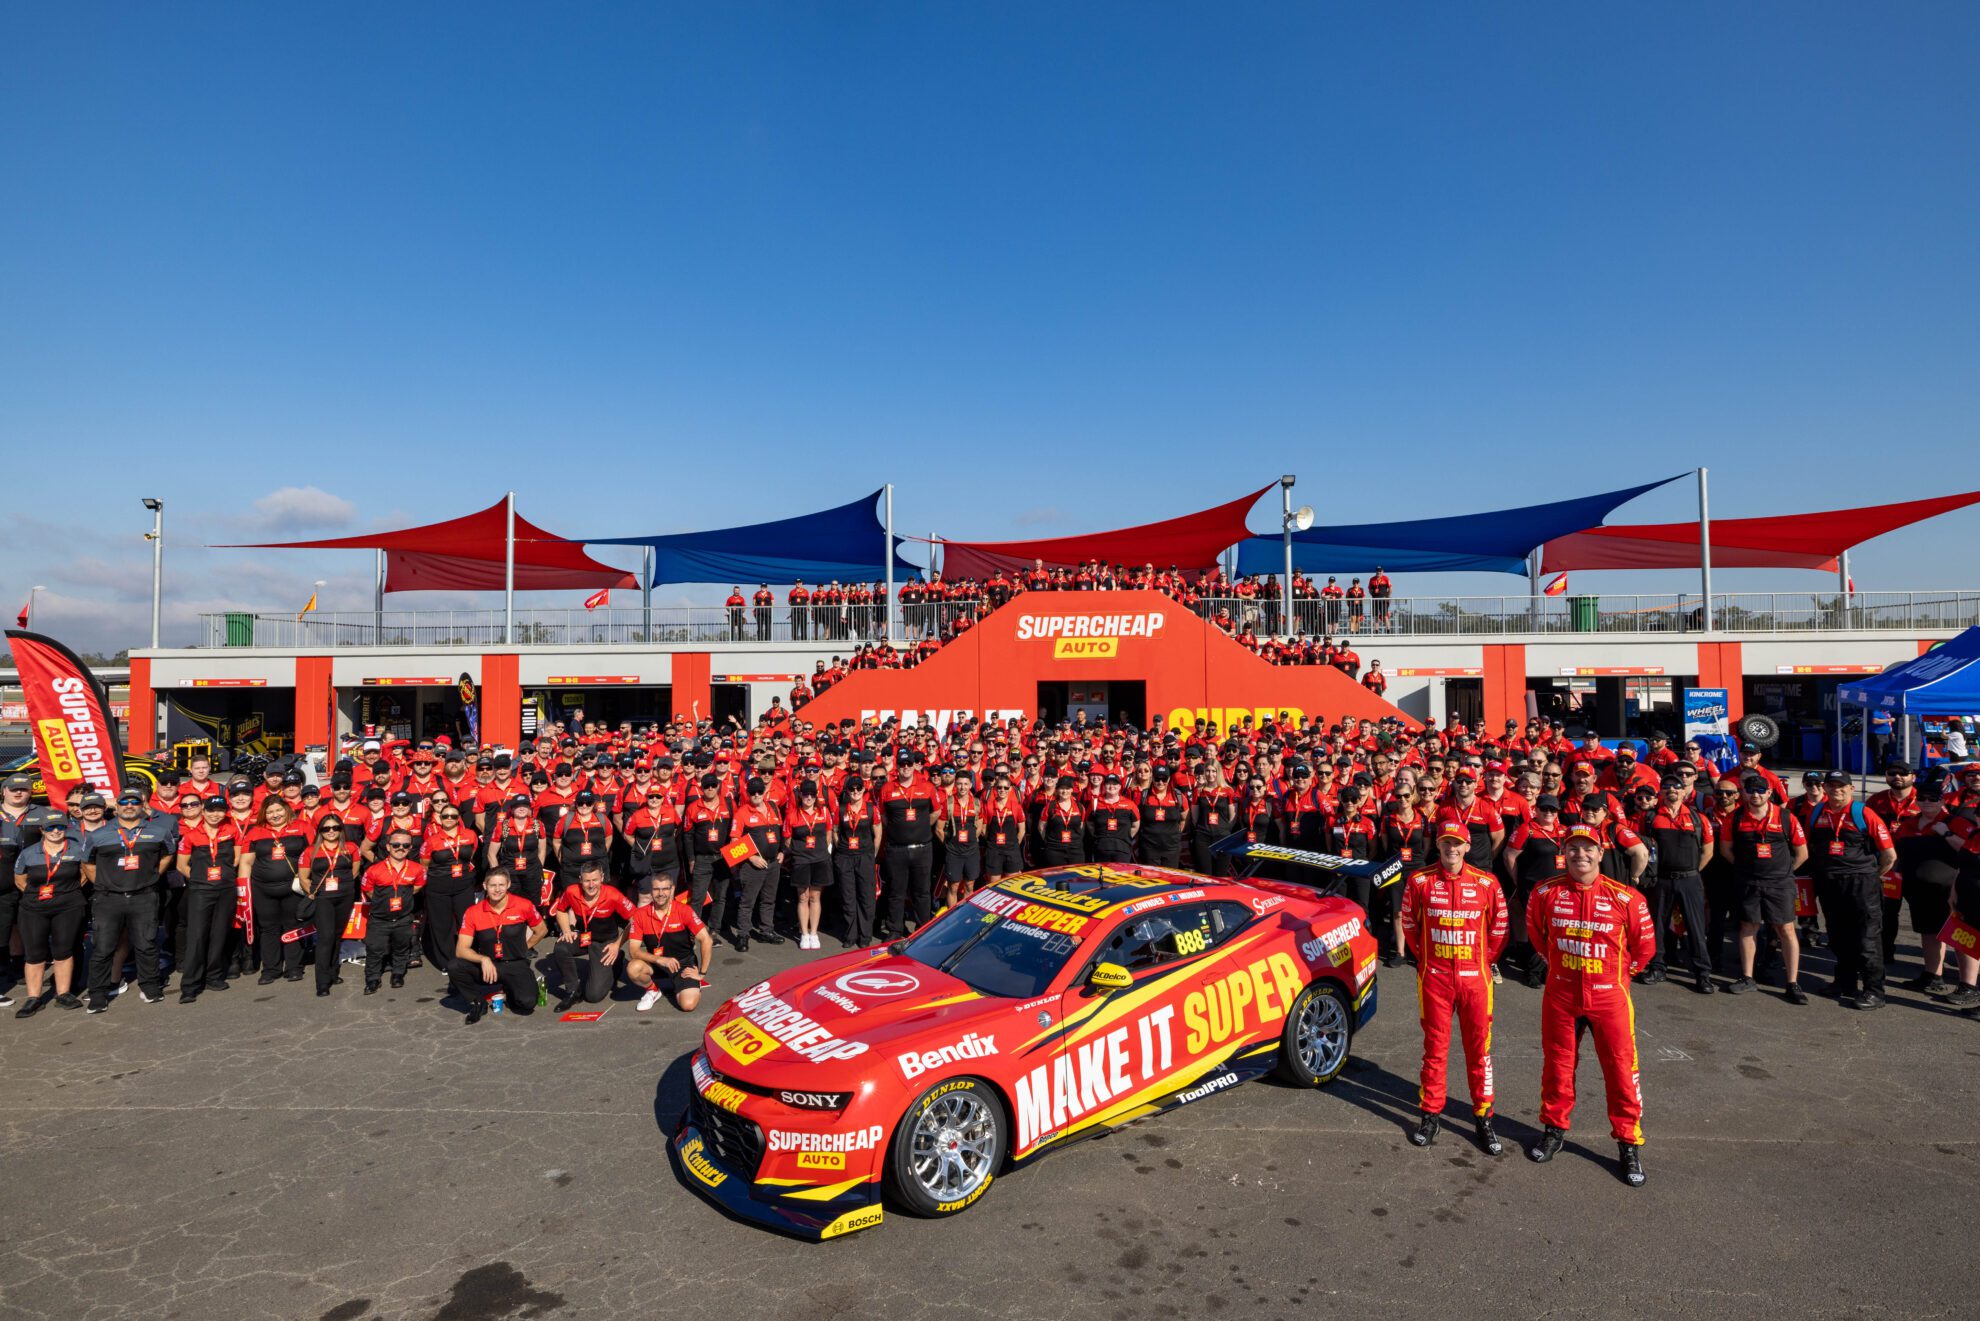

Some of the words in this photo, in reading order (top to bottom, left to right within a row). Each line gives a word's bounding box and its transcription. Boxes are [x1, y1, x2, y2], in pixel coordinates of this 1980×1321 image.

[1016, 612, 1164, 640] SUPERCHEAP
[1061, 641, 1111, 654] AUTO
[1687, 704, 1725, 717] WHEEL
[52, 677, 114, 799] SUPERCHE
[45, 725, 73, 773] AUTO
[730, 843, 749, 858] 888
[1248, 842, 1370, 867] SUPERCHEAP
[1254, 850, 1289, 859] AUTO
[1294, 856, 1333, 868] TRADE
[1382, 860, 1403, 879] BOSCH
[998, 873, 1110, 912] Century
[1179, 889, 1205, 900] MURRAY
[969, 888, 1010, 913] MAKE
[1001, 899, 1027, 917] IT
[1016, 904, 1088, 935] SUPER
[1132, 897, 1165, 912] LOWNDES
[1427, 908, 1481, 920] SUPERCHEAP
[1001, 919, 1050, 941] Lowndes
[1551, 917, 1614, 933] SUPERCHEAP
[1175, 929, 1206, 956] 888
[1302, 917, 1361, 962] SUPERCHEAP
[1431, 928, 1464, 944] MAKE
[1466, 930, 1477, 944] IT
[1952, 928, 1976, 948] 888
[1331, 947, 1350, 963] AUTO
[1435, 944, 1472, 960] SUPER
[1557, 938, 1593, 956] MAKE
[1594, 943, 1608, 958] IT
[1561, 954, 1604, 974] SUPER
[1092, 970, 1127, 981] ACDelco
[1024, 994, 1061, 1010] DUNLOP
[733, 982, 869, 1064] SUPERCHEAP
[720, 1023, 763, 1055] AUTO
[898, 1032, 999, 1080] Bendix
[1015, 1028, 1134, 1150] MAKE
[1138, 1004, 1175, 1081] IT
[1183, 952, 1303, 1055] SUPER
[705, 1081, 748, 1113] SUPER
[922, 1081, 975, 1110] DUNLOP
[1176, 1072, 1239, 1104] ToolPRO
[781, 1091, 842, 1111] SONY
[768, 1125, 883, 1153] SUPERCHEAP
[681, 1138, 728, 1188] Century
[802, 1153, 841, 1167] AUTO
[966, 1173, 993, 1205] SPORT
[936, 1199, 966, 1212] MAXX
[848, 1213, 882, 1230] BOSCH
